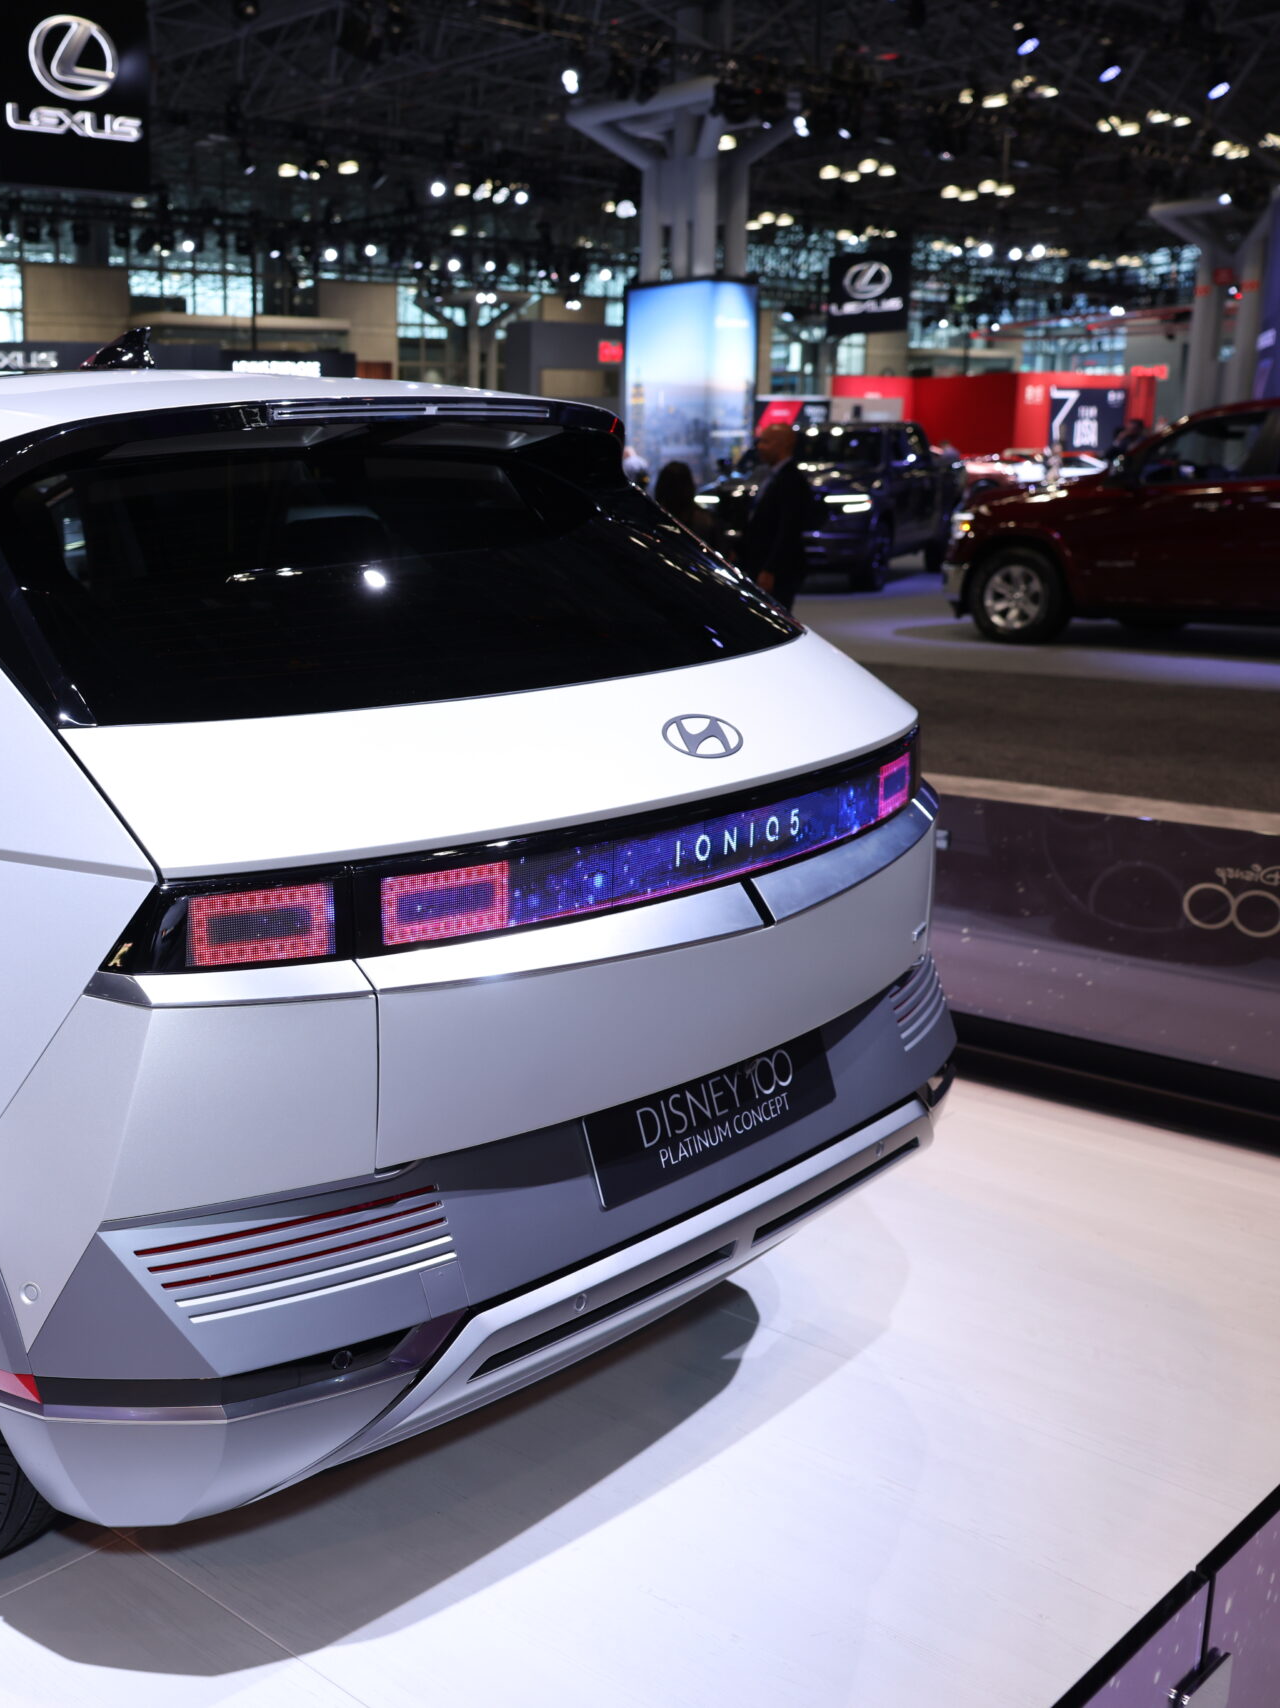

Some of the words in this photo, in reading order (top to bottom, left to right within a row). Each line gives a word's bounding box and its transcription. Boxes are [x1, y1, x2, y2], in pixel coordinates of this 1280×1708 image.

[5, 102, 144, 143] LEXUS
[635, 1071, 741, 1149] DISNEY
[745, 1049, 793, 1100] 100
[659, 1120, 732, 1169] PLATINUM
[733, 1092, 789, 1135] CONCEPT
